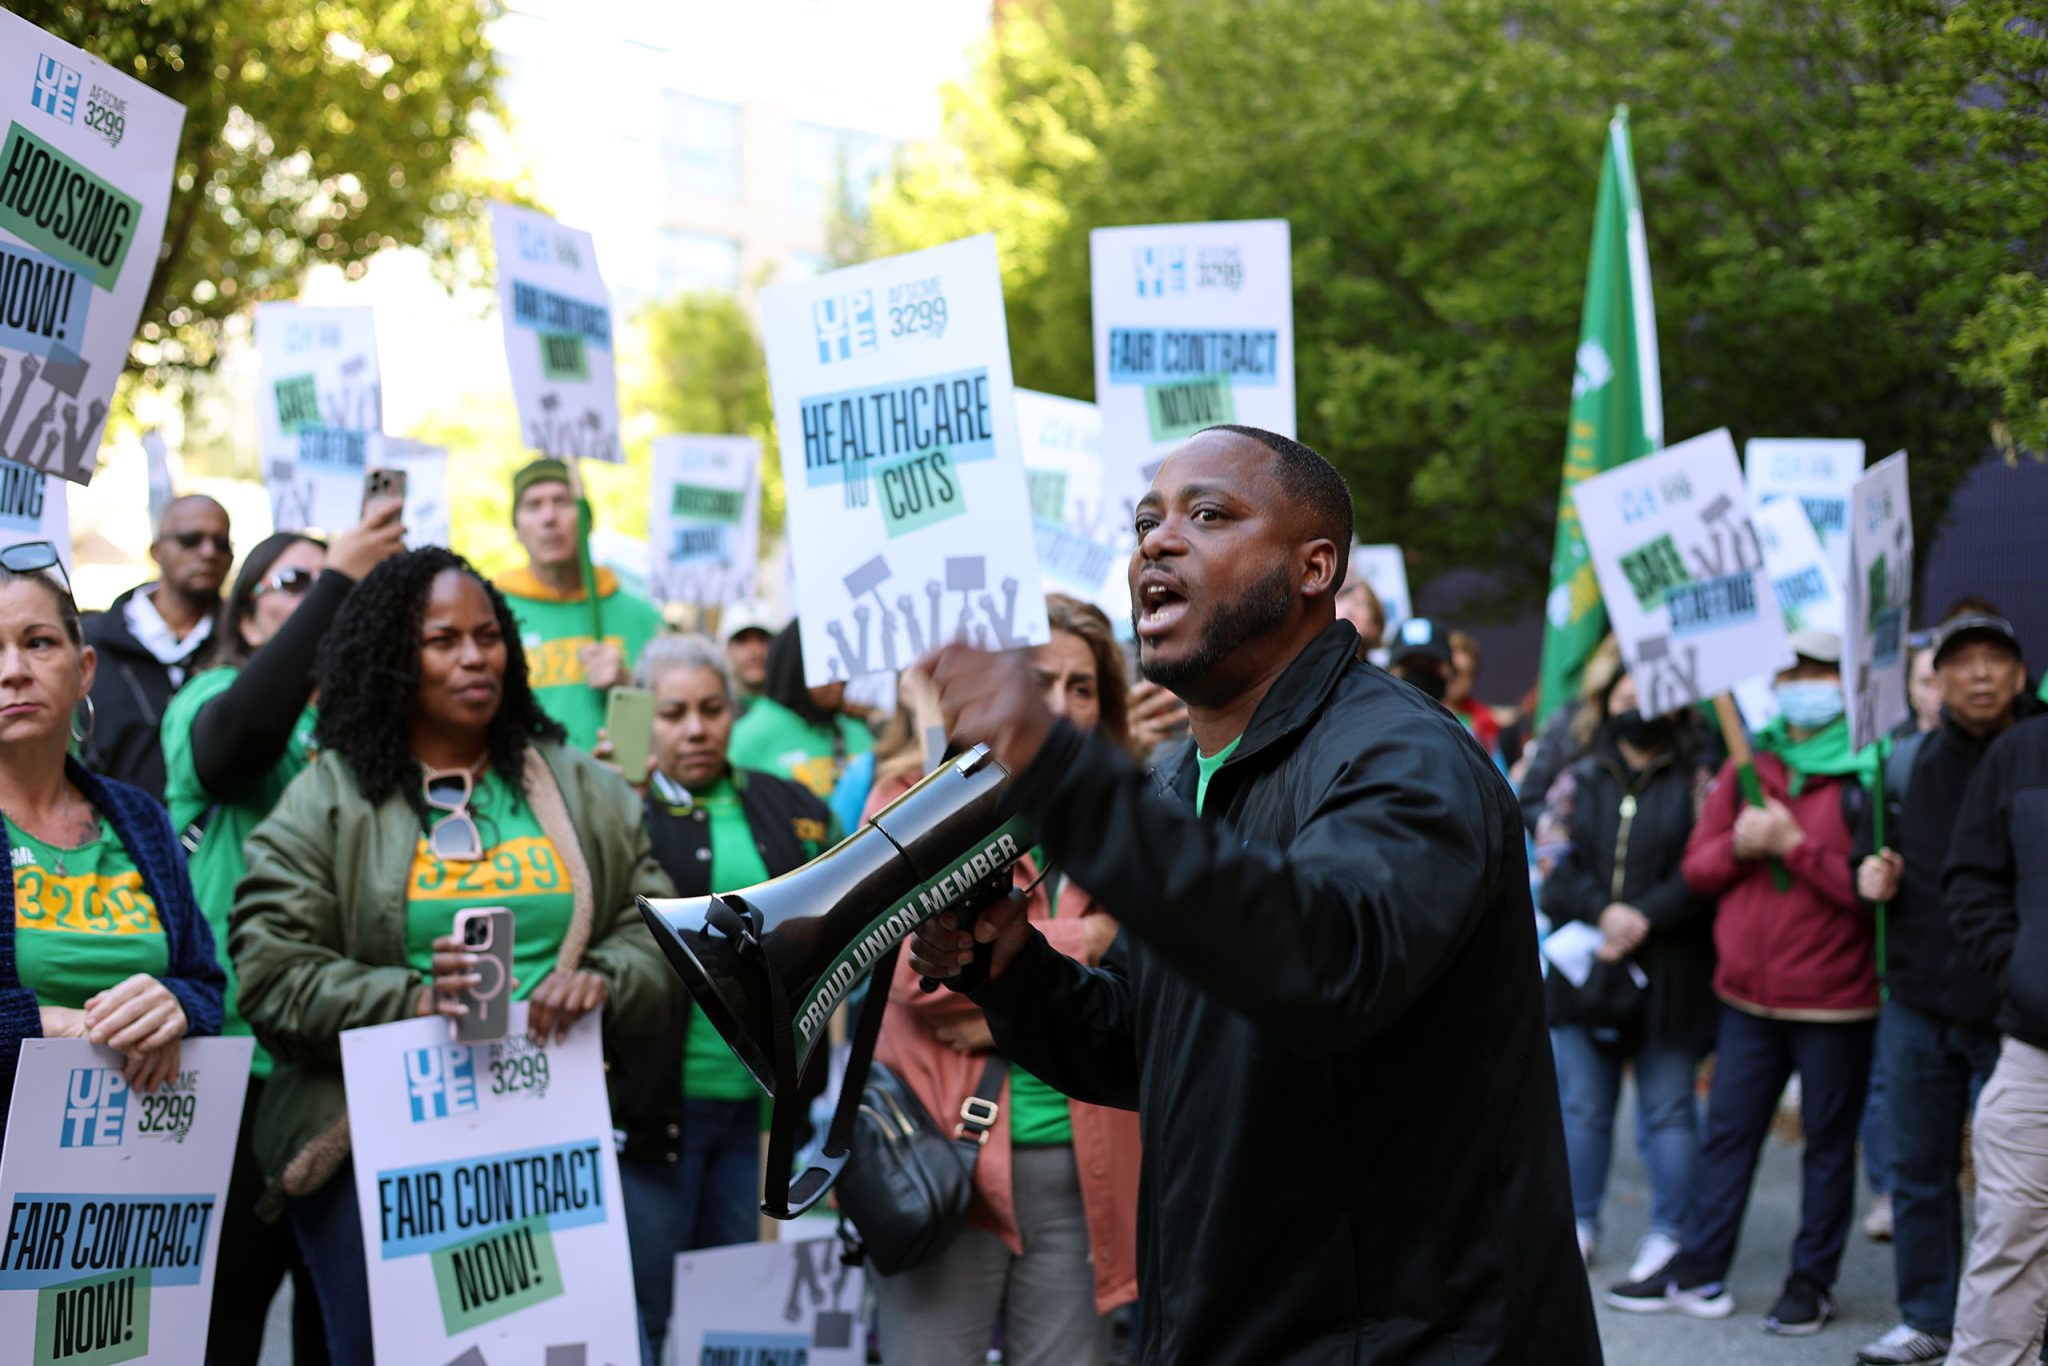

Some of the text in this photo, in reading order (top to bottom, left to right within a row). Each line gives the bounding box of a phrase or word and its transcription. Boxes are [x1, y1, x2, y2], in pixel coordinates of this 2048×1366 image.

[84, 101, 125, 139] 3299
[0, 136, 130, 267] HOUSING
[889, 296, 947, 337] 3299
[1110, 331, 1277, 373] FAIR CONTRACT
[802, 375, 991, 469] HEALTHCARE
[883, 452, 954, 520] CUTS
[17, 871, 152, 932] 3299
[798, 833, 1018, 1042] PROUD UNION MEMBER
[489, 1052, 549, 1095] 3299
[138, 1094, 196, 1132] 3299
[378, 1146, 601, 1241] FAIR CONTRACT
[0, 1202, 214, 1270] FAIR CONTRACT
[452, 1225, 543, 1313] NOW!
[53, 1276, 135, 1360] NOW!
